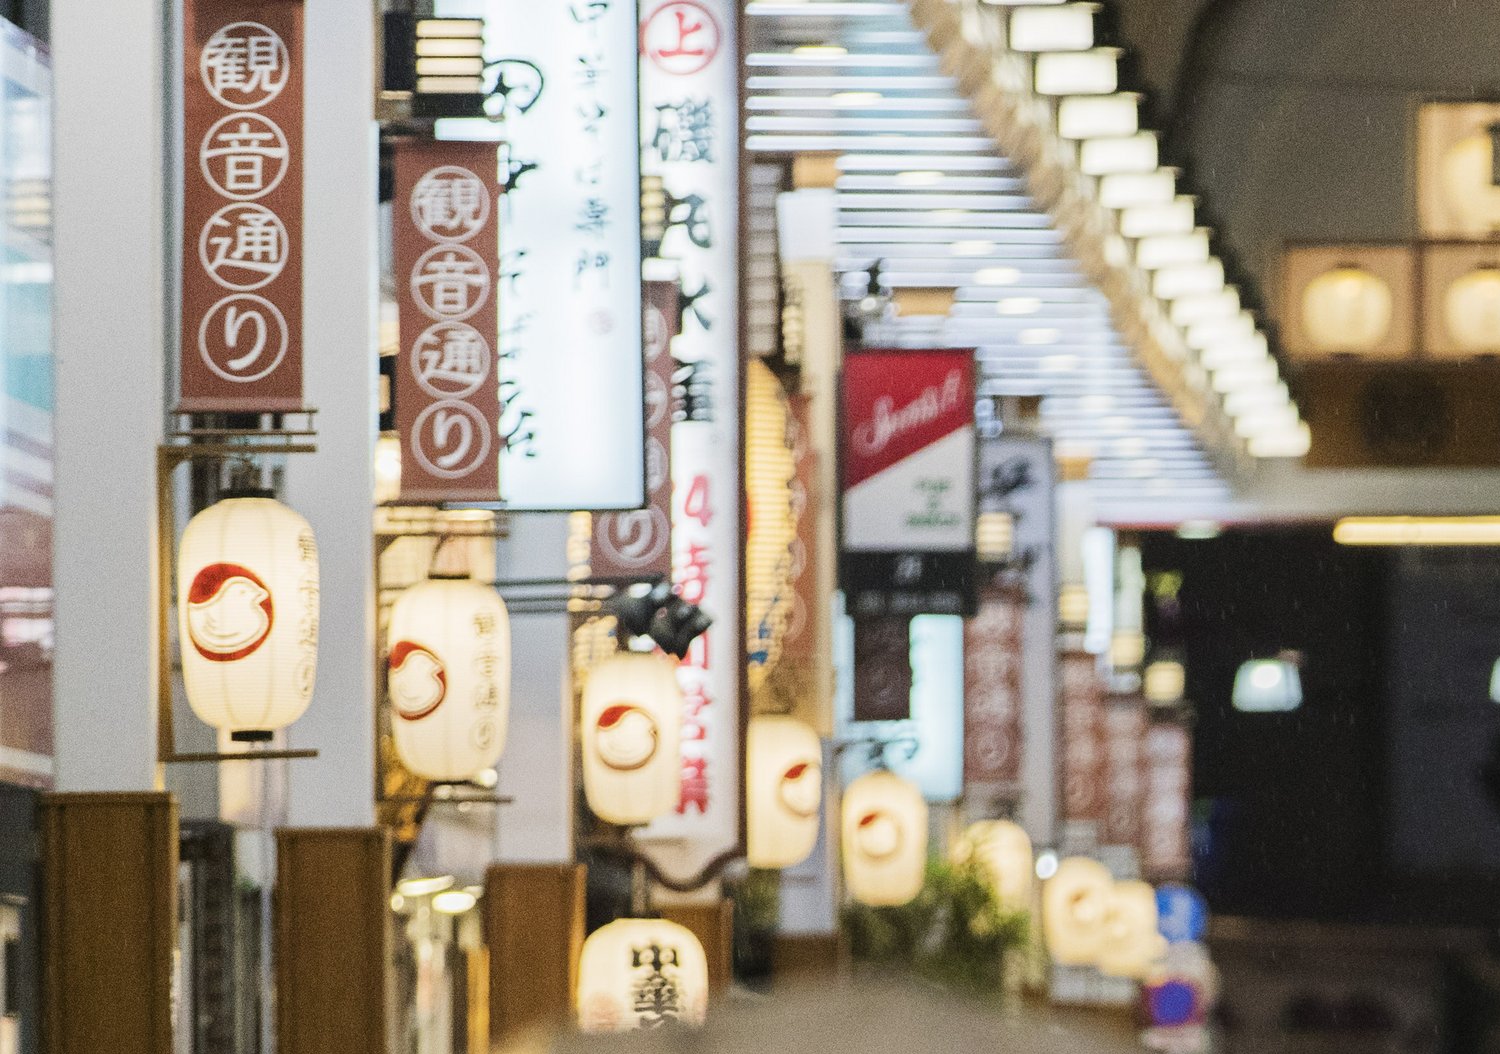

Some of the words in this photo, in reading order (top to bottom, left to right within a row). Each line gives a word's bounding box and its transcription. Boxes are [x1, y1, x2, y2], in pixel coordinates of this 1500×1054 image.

[201, 24, 289, 382] 観音通り
[411, 168, 490, 478] 観音通り
